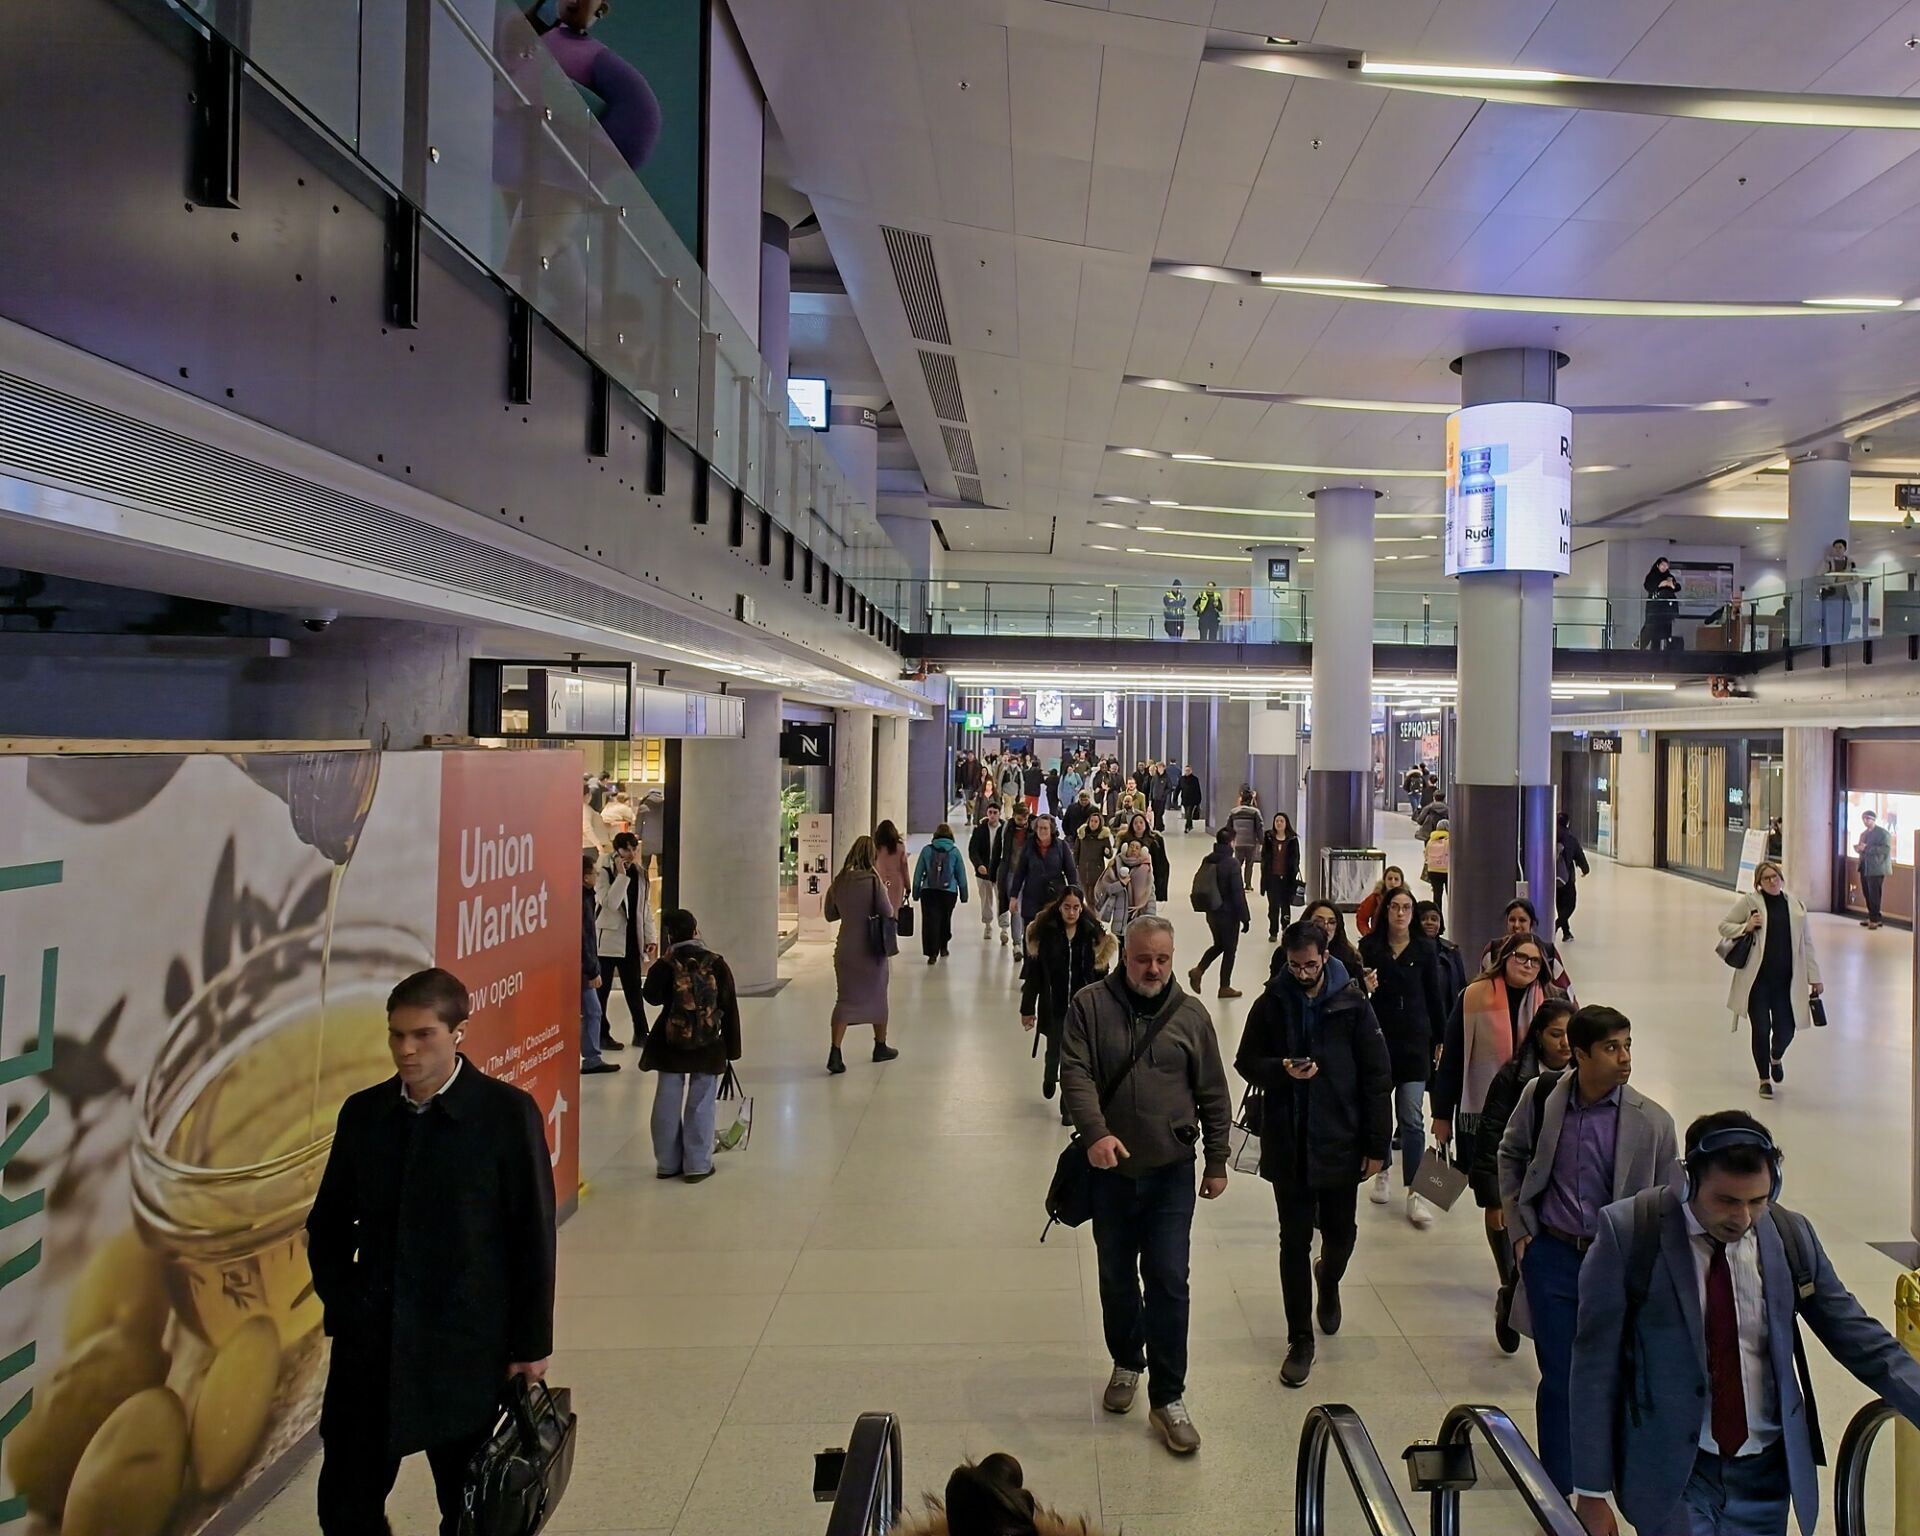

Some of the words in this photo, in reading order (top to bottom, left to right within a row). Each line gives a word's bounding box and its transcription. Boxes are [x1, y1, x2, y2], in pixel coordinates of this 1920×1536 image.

[1465, 526, 1495, 543] Ryde
[1274, 564, 1285, 572] UP
[967, 716, 983, 728] TD
[1400, 721, 1432, 738] SEPHORA
[799, 733, 822, 758] N
[460, 824, 534, 889] Union
[457, 880, 548, 960] Market
[468, 986, 487, 1015] ow
[490, 971, 523, 1008] open
[490, 1055, 504, 1071] The
[505, 1045, 521, 1064] Alley
[542, 1040, 564, 1060] Express
[1430, 1176, 1443, 1187] alo
